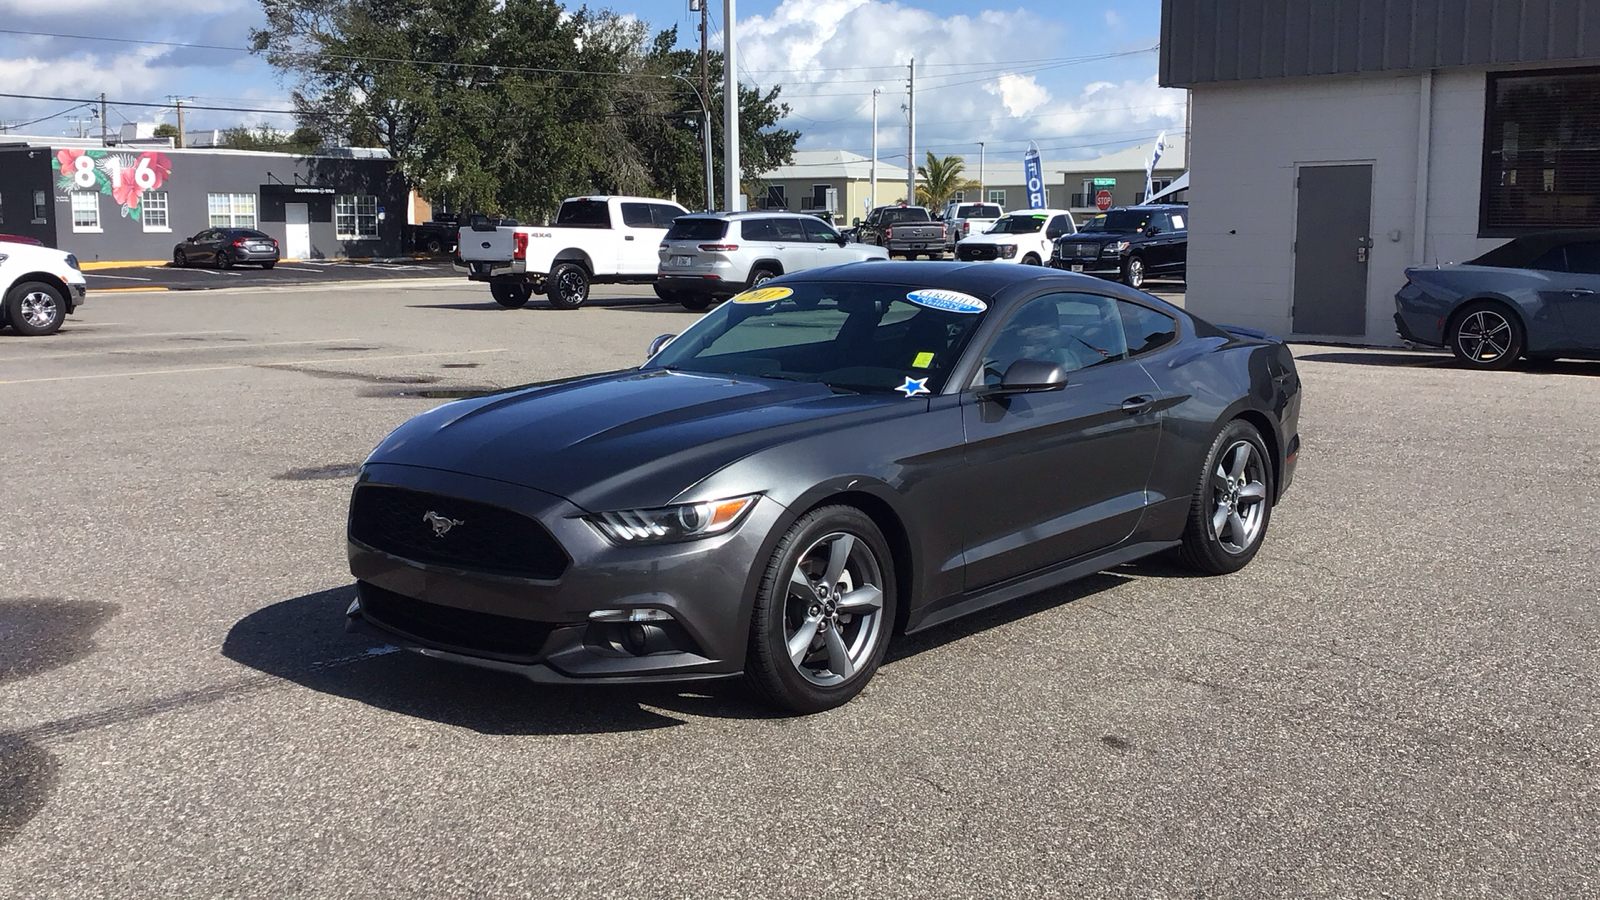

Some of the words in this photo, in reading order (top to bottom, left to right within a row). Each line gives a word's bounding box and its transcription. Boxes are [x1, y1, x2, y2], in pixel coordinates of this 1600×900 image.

[75, 155, 156, 189] 816
[1097, 196, 1111, 205] STOP
[738, 288, 787, 301] 2017
[919, 290, 981, 306] CERTIFIED
